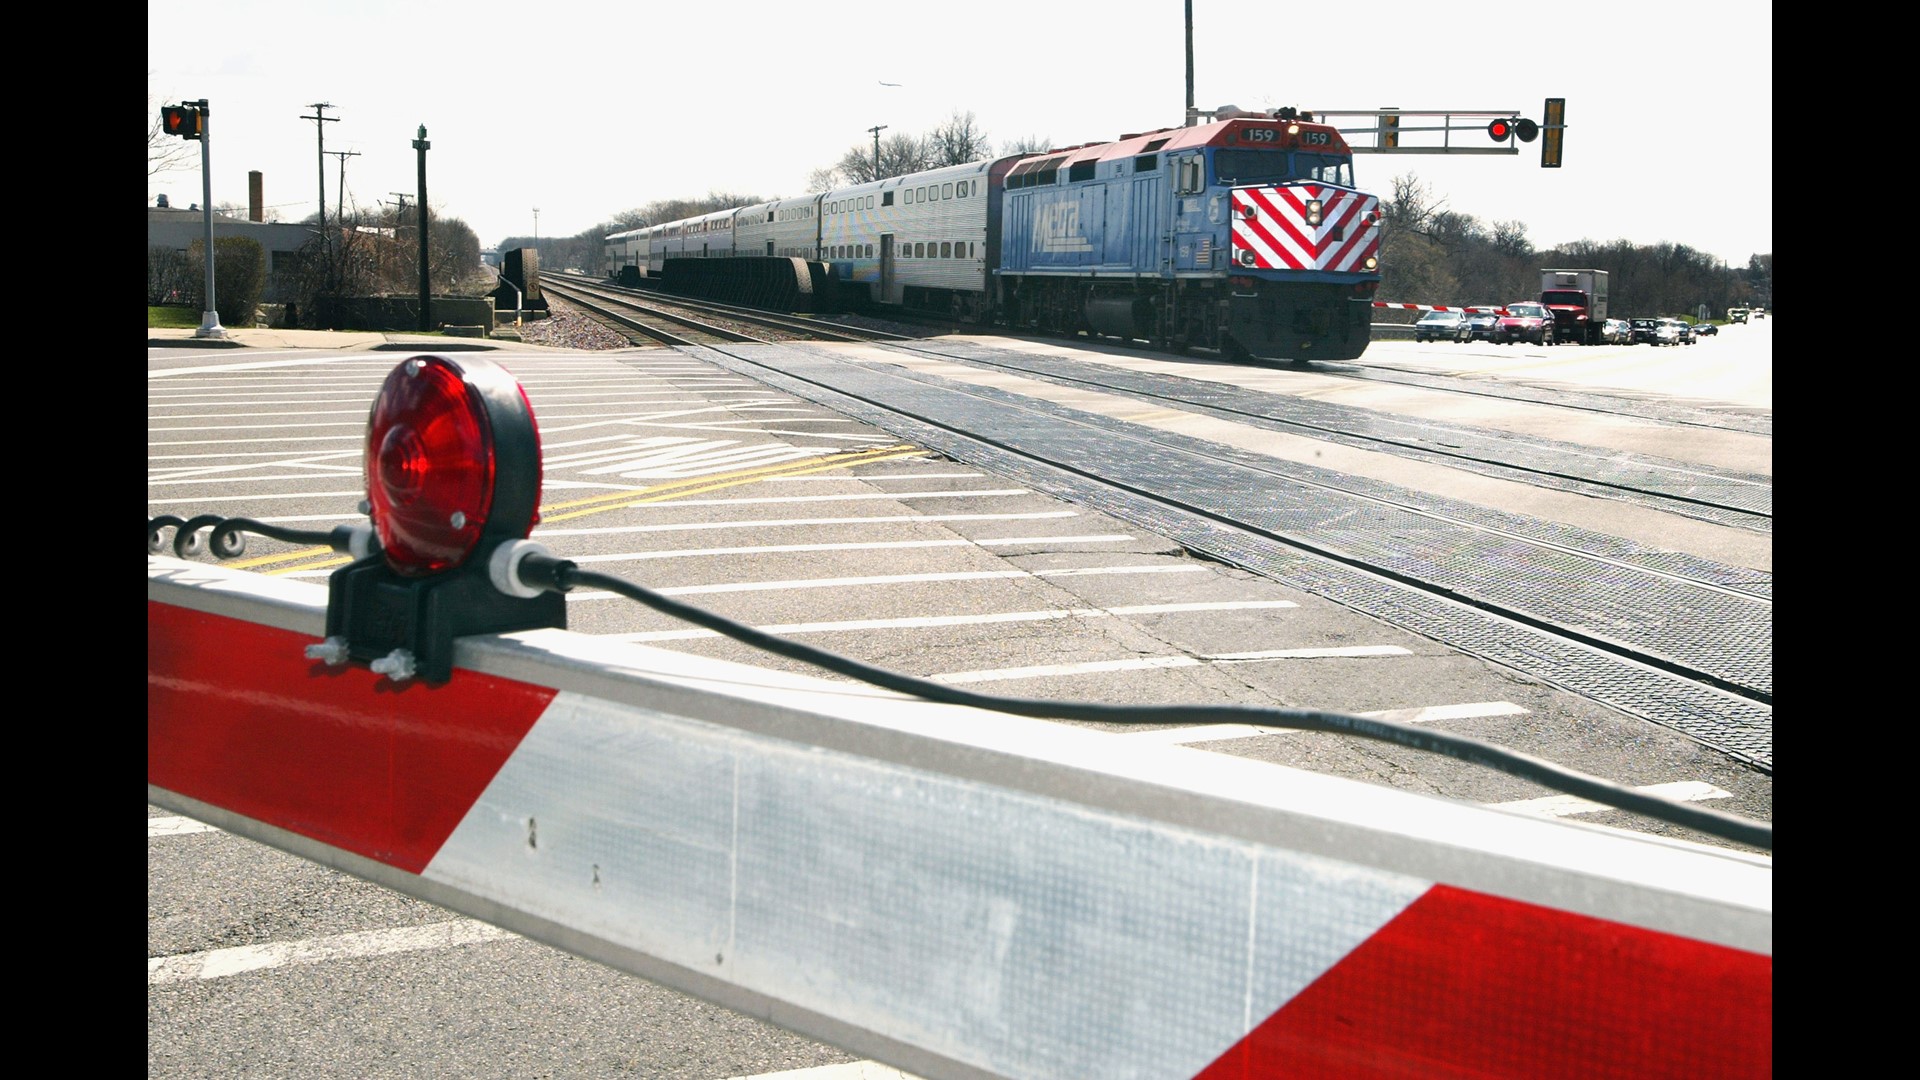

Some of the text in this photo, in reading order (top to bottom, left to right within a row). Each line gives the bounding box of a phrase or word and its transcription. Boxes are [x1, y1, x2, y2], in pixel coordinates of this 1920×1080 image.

[1248, 128, 1274, 142] 159
[1305, 131, 1328, 145] 159
[1031, 199, 1082, 253] Metra
